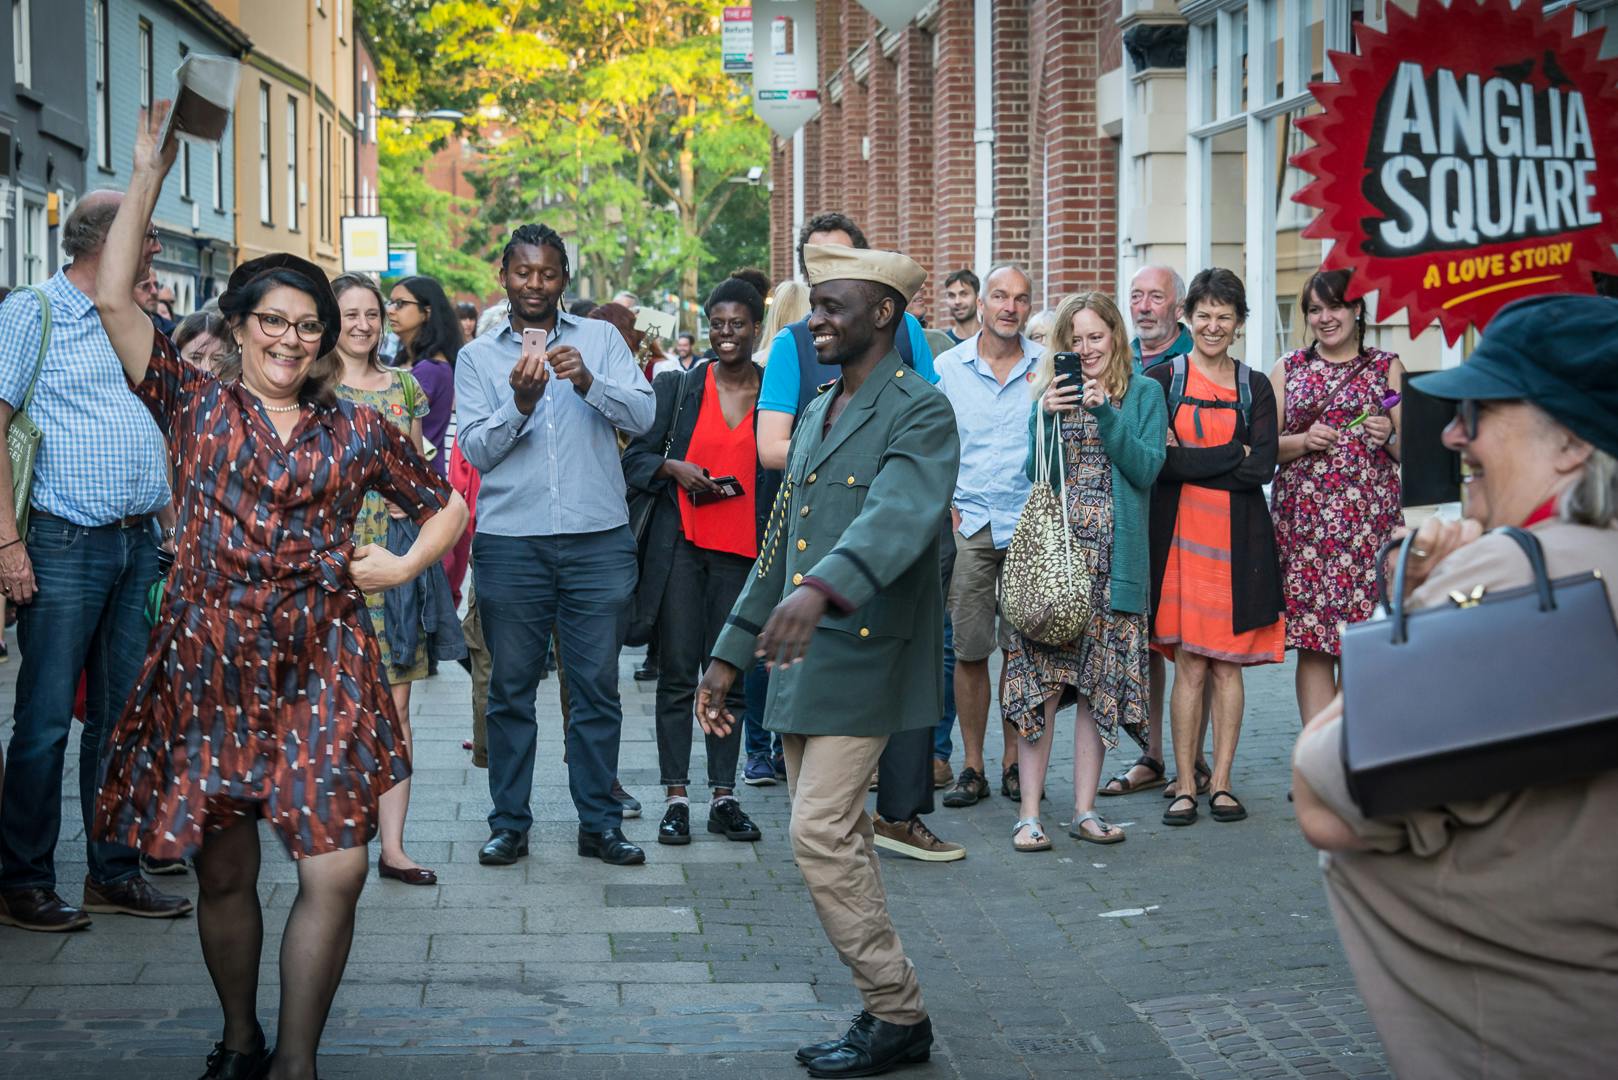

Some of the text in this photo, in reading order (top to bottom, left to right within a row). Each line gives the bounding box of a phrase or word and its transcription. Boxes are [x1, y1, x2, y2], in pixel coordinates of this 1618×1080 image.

[1383, 62, 1595, 159] ANGLIA
[1379, 155, 1602, 249] SQUARE
[1423, 242, 1573, 289] A LOVE STORY
